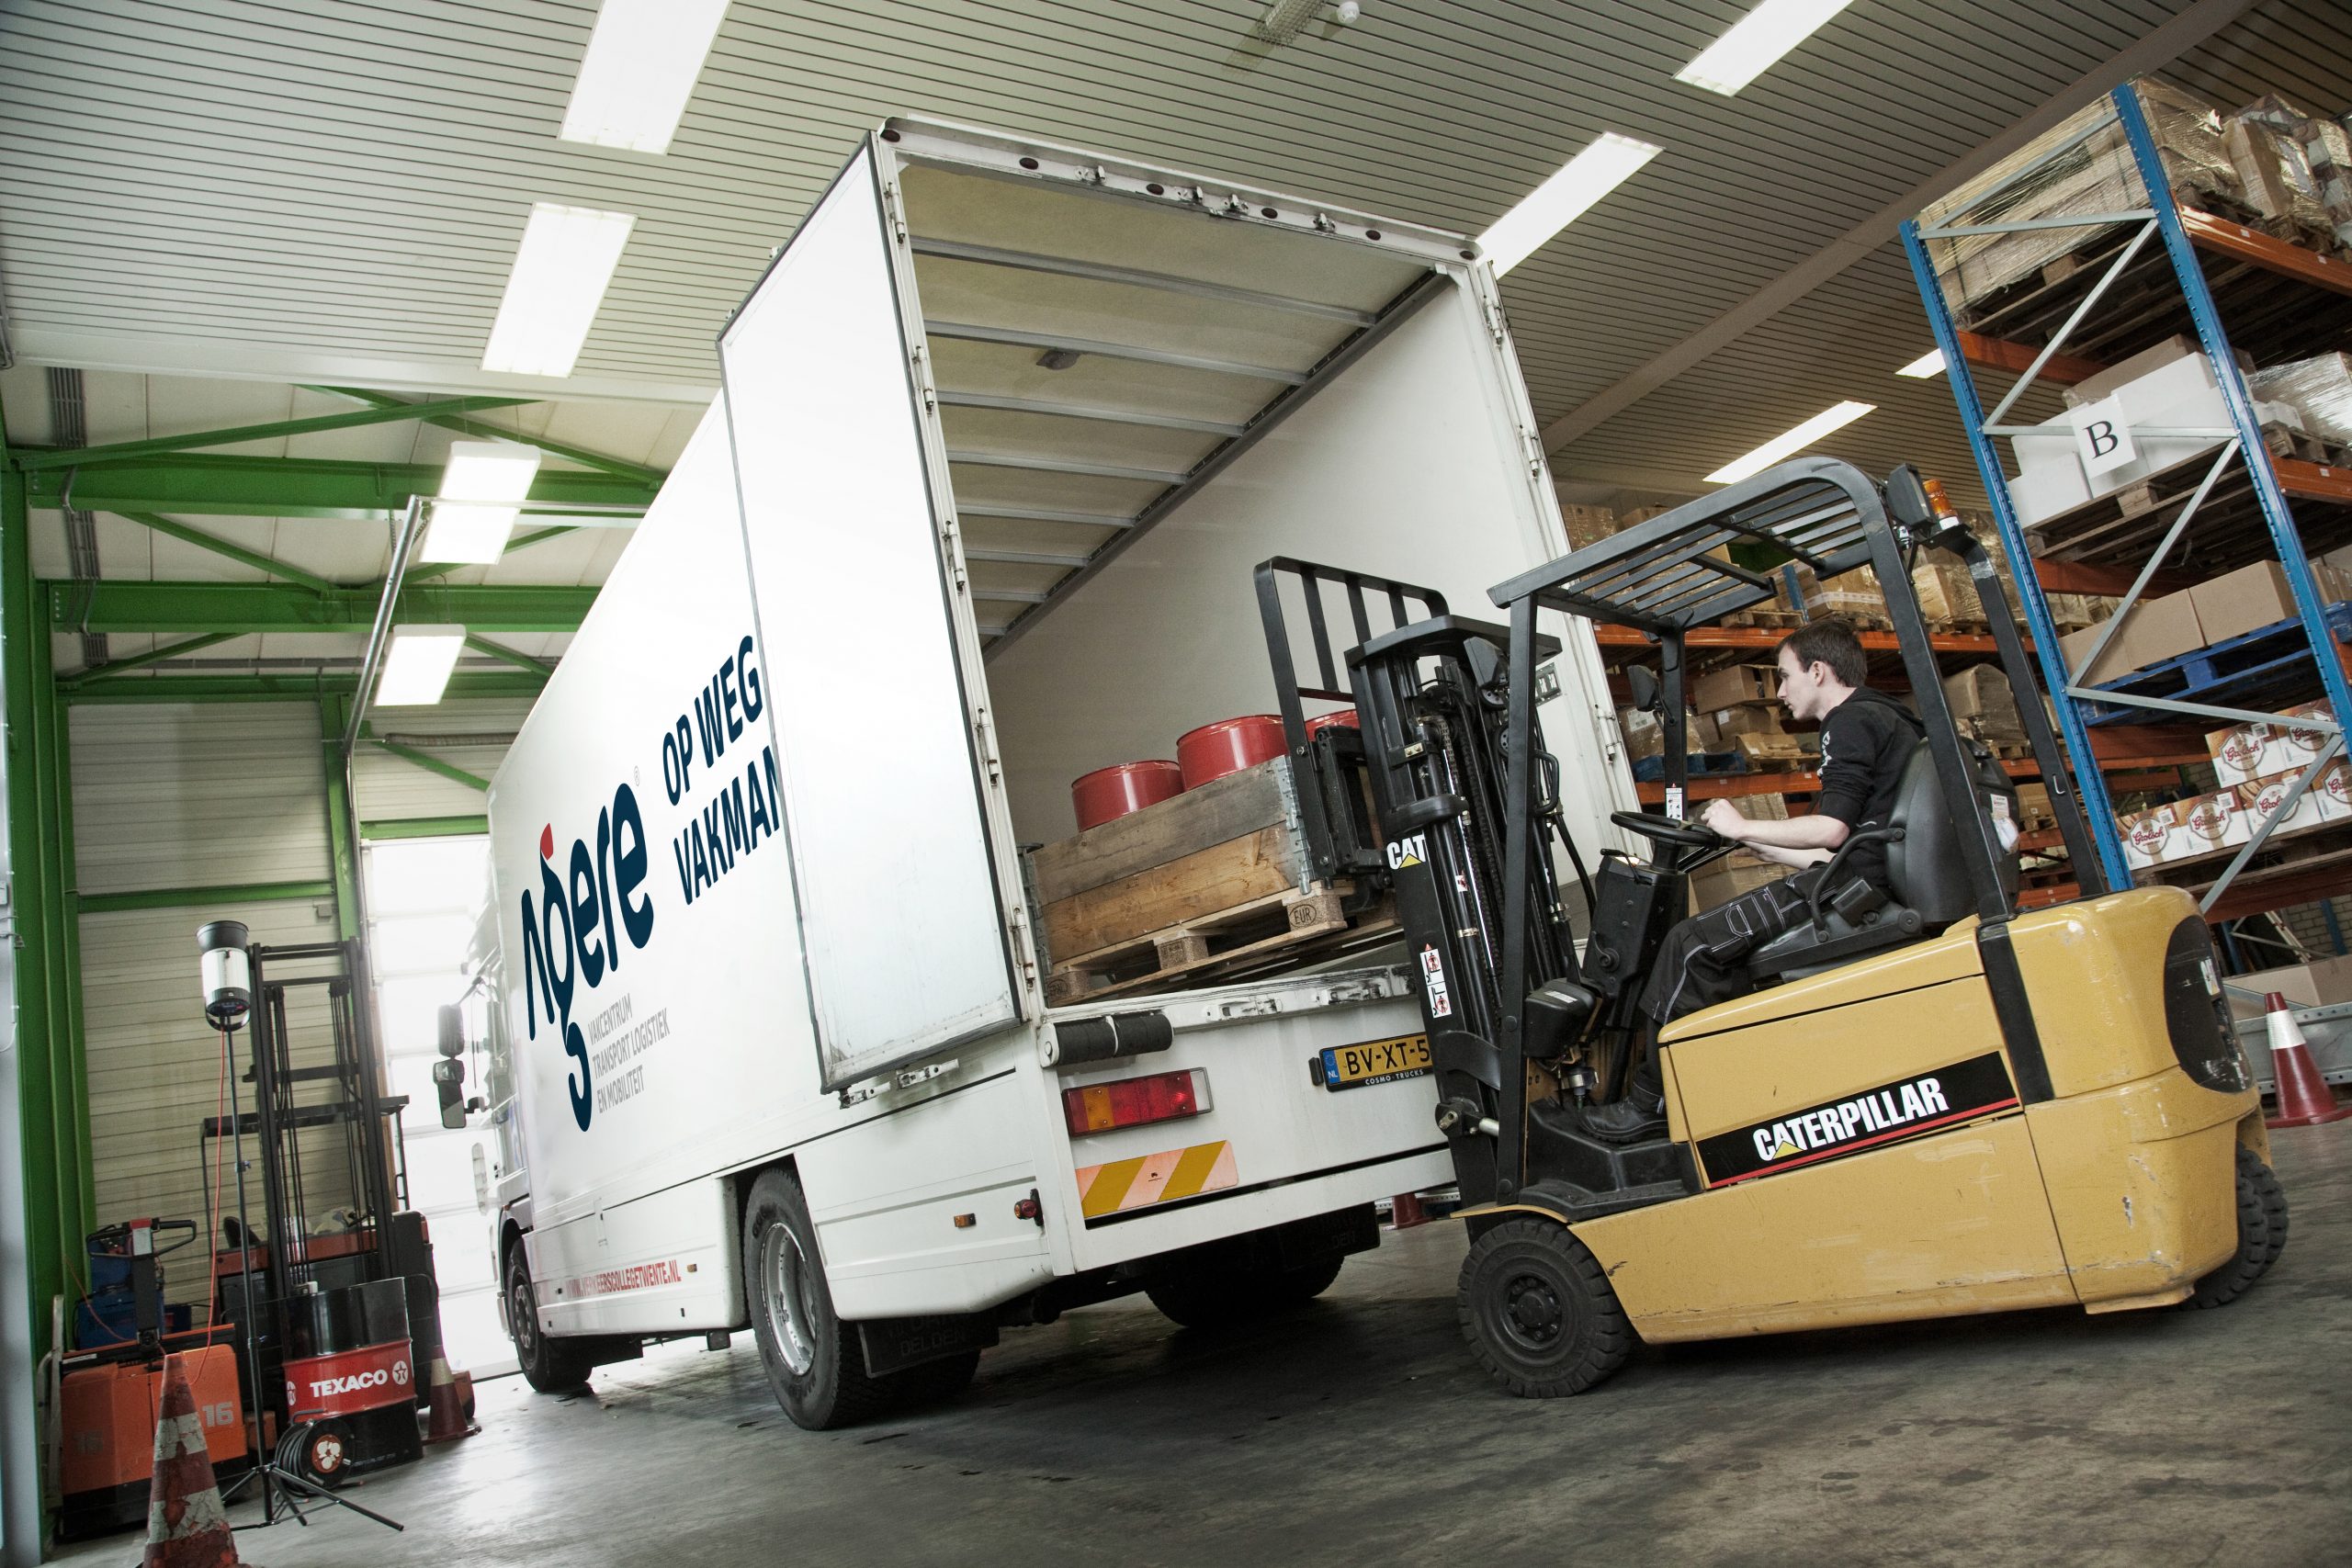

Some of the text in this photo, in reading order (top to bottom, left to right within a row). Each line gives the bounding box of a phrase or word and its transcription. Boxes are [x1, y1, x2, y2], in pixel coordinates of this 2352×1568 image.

[2082, 420, 2119, 459] B
[662, 635, 763, 807] OP WEG
[1386, 832, 1426, 870] CAT
[2132, 826, 2165, 845] Grolsch
[1294, 907, 1312, 925] EUR
[588, 992, 633, 1045] VAKCENTRUM
[592, 1007, 671, 1079] TRANSPORT LOGISTIEK
[597, 1064, 645, 1113] EN MOBILITEIT
[1328, 1070, 1339, 1079] NL
[1365, 1069, 1424, 1086] COSMO TRUCKS
[1752, 1077, 1950, 1161] CATERPILLAR
[310, 1369, 389, 1397] TEXACO
[202, 1401, 234, 1427] 16
